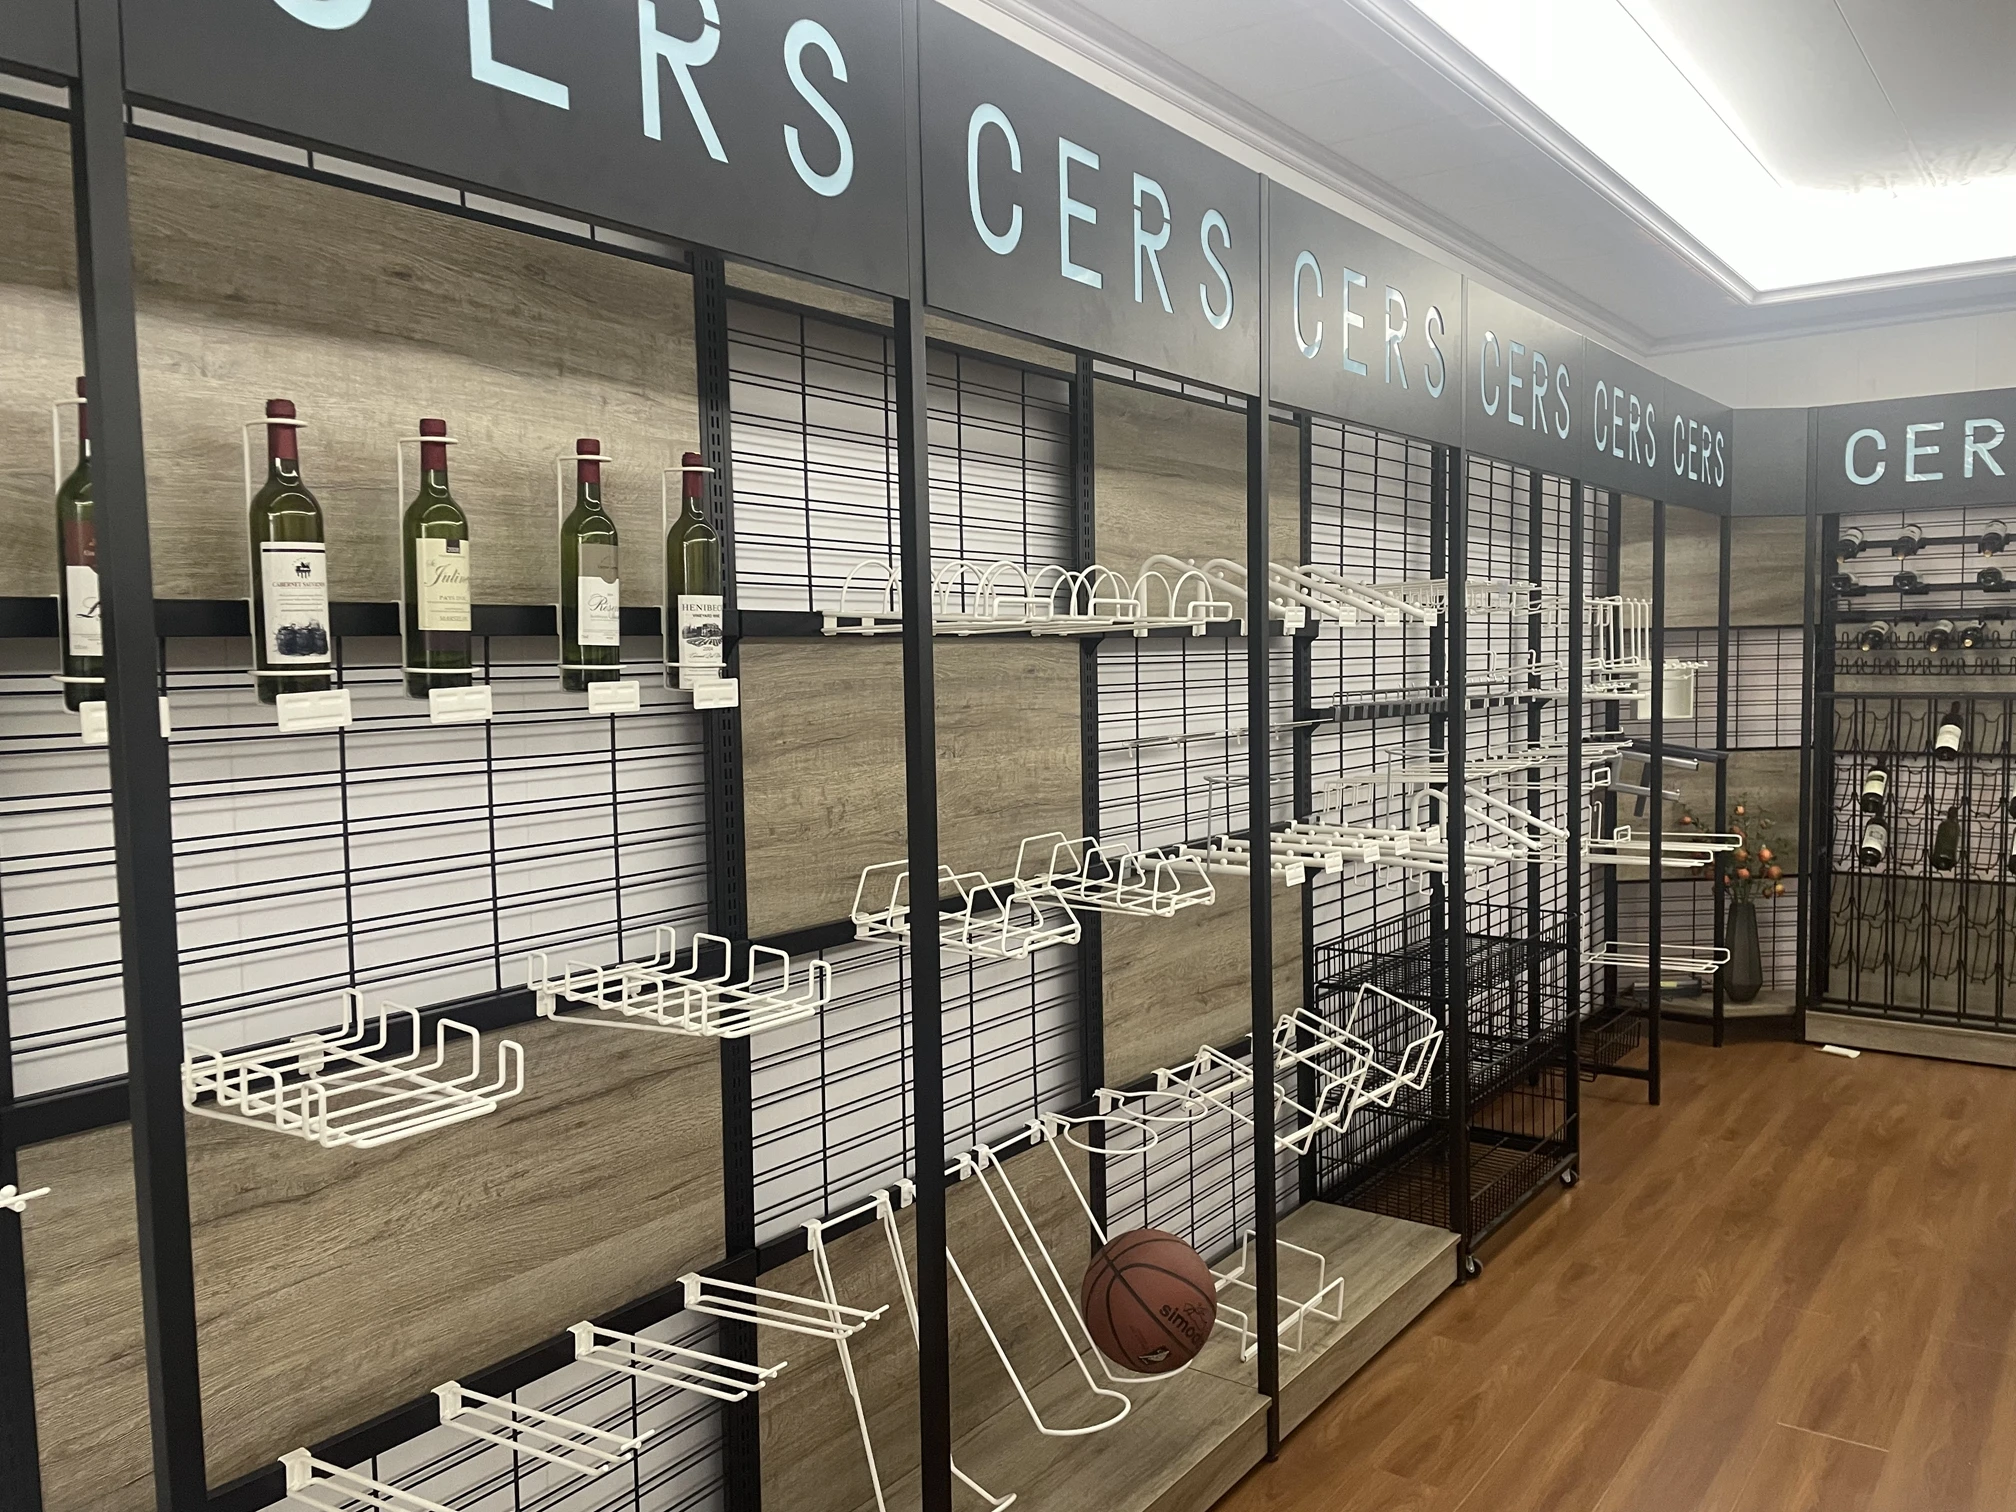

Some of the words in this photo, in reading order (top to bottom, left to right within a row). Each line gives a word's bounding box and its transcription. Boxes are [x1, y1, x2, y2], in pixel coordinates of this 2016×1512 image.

[273, 0, 854, 197] RS
[967, 103, 1235, 331] CERS
[1293, 250, 1445, 398] CERS
[1480, 330, 1571, 440] CERS
[1594, 379, 1657, 468] CERS
[1673, 414, 1725, 488] CERS
[1845, 418, 2006, 486] CER
